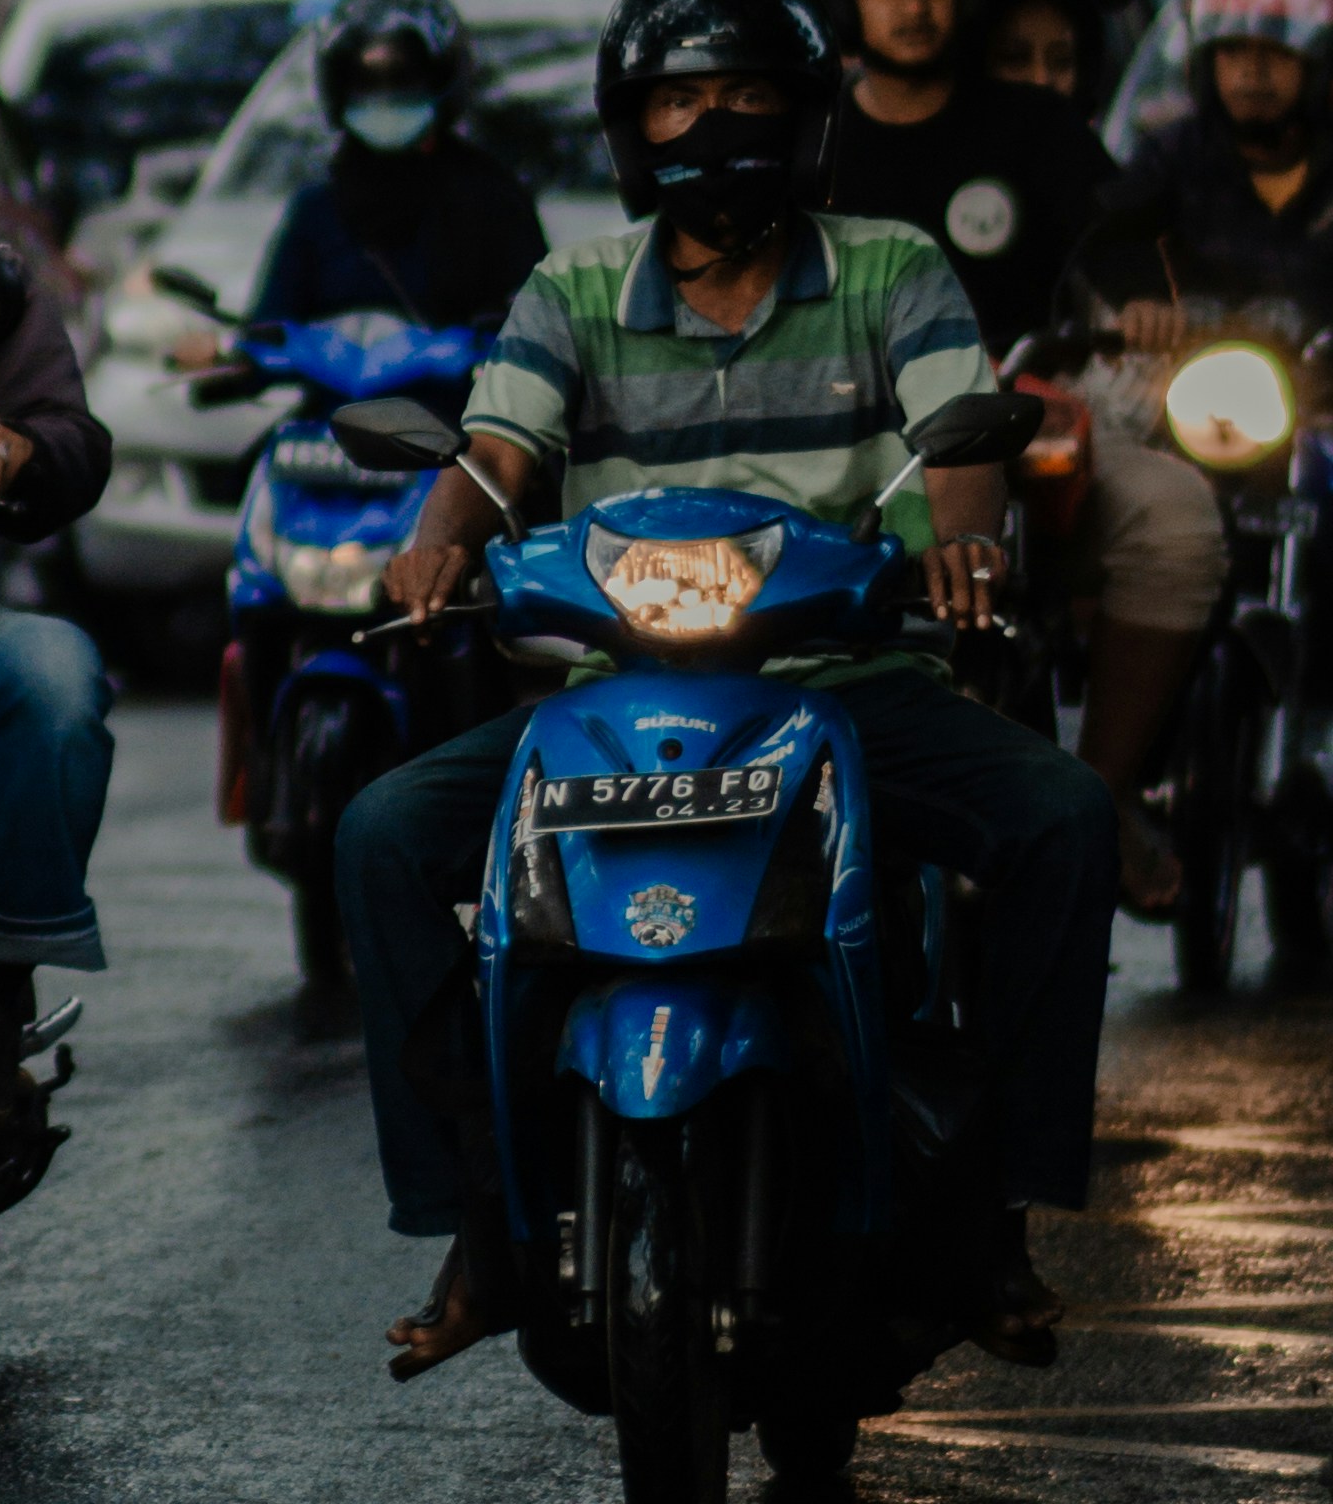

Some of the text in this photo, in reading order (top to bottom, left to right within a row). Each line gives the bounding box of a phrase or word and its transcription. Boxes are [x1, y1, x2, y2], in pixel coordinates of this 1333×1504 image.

[634, 714, 717, 733] SUZUKI
[543, 781, 569, 807] N
[592, 775, 695, 802] 5776
